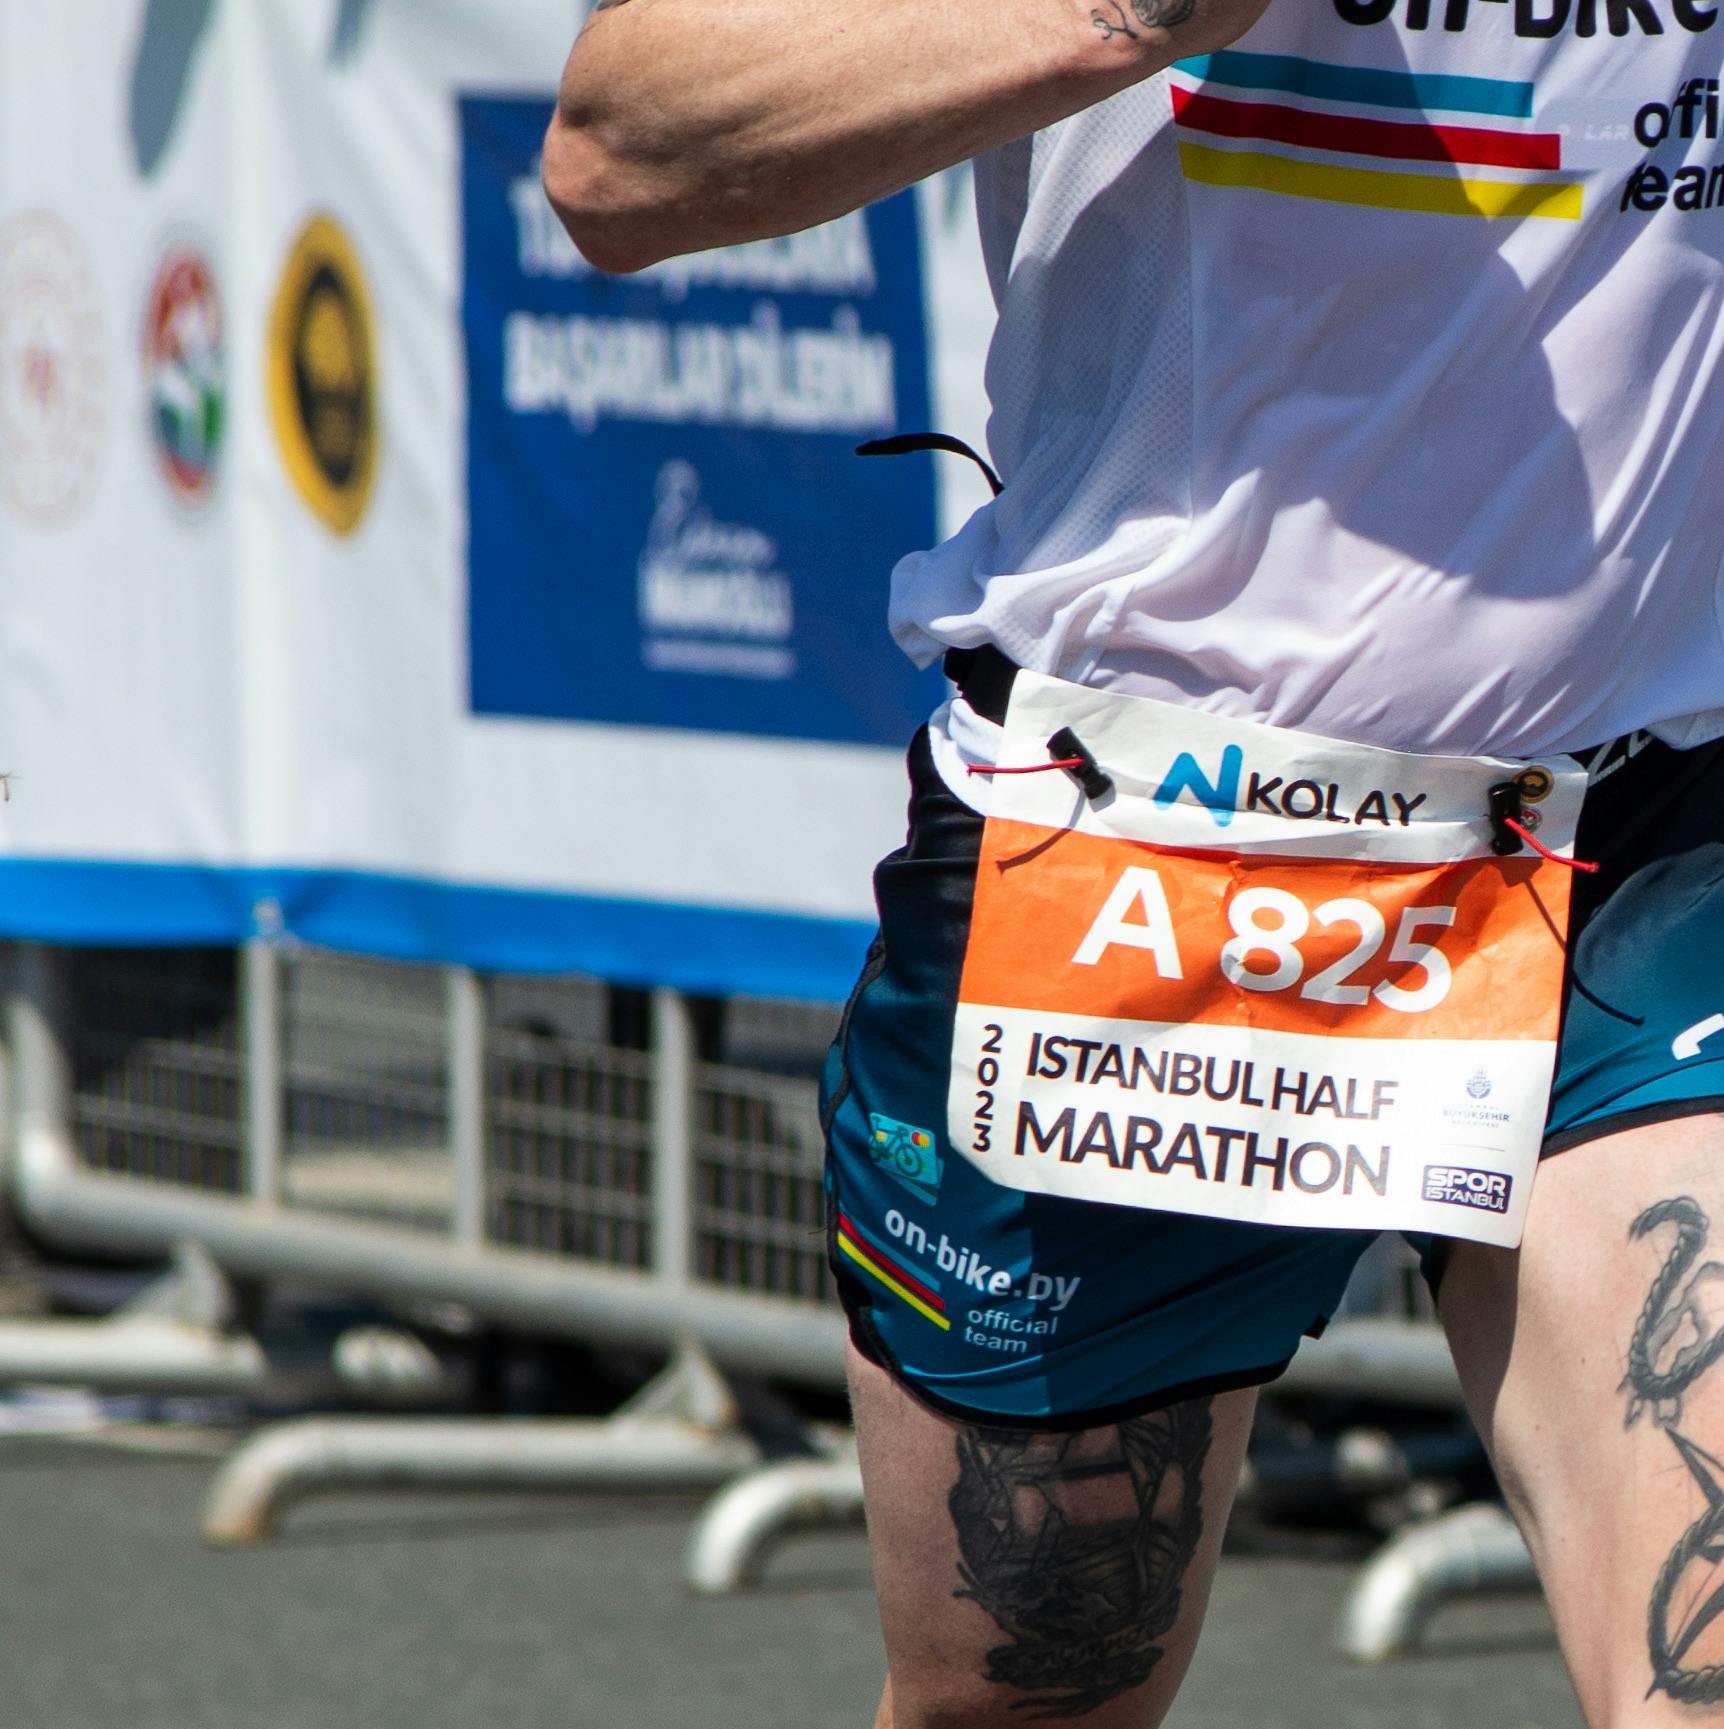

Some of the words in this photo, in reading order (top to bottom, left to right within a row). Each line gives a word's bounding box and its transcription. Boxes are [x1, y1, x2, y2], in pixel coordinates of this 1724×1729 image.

[1247, 771, 1428, 827] KOLAY
[1071, 865, 1184, 980] A
[1220, 886, 1457, 1013] 825
[1025, 1032, 1265, 1108] ISTANBUL
[1271, 1066, 1399, 1121] HALF
[1013, 1100, 1391, 1197] MARATHON
[1427, 1167, 1507, 1197] SPOR
[885, 1208, 1082, 1312] on-bike.by
[963, 1326, 1028, 1355] team
[967, 1308, 1059, 1336] official
